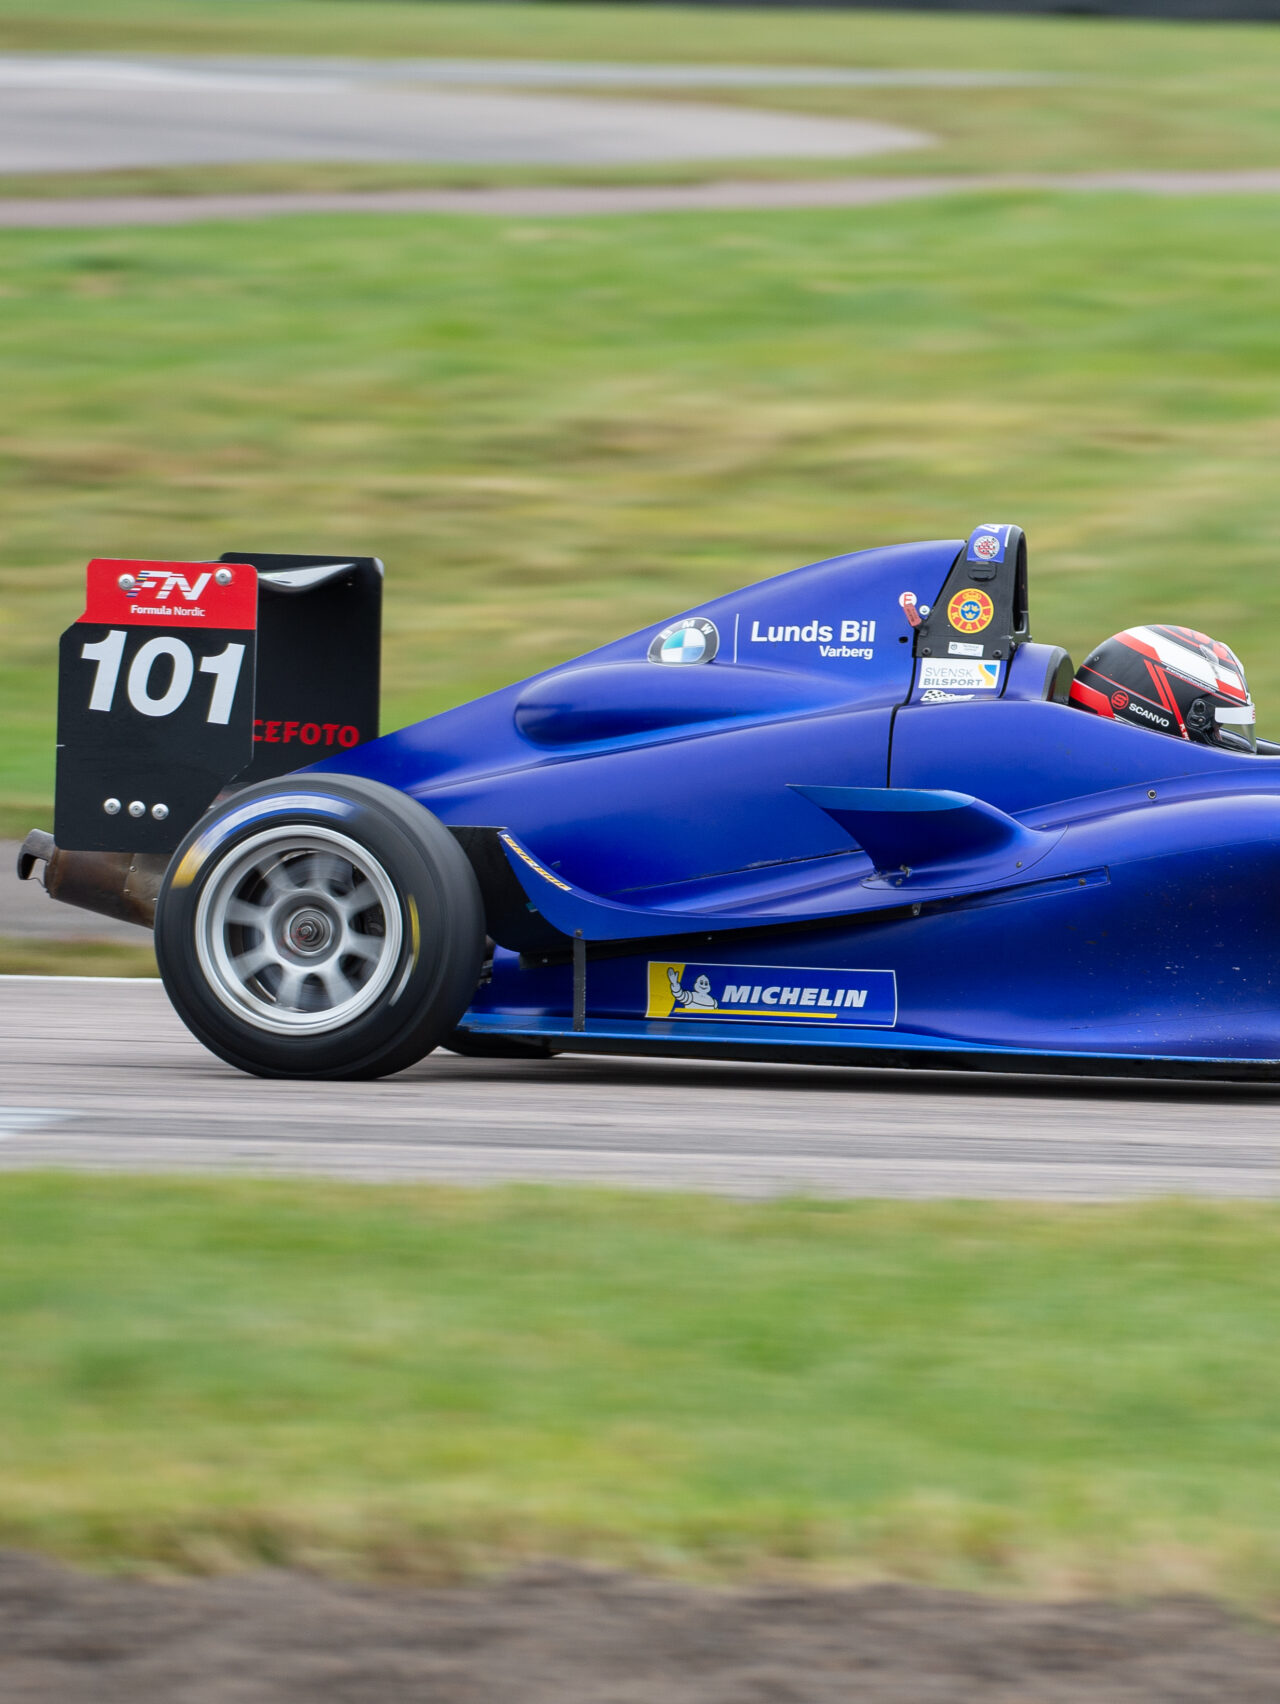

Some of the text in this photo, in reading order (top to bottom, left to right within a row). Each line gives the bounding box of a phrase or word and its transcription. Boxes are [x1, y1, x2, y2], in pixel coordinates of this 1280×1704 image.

[130, 604, 206, 617] Formula Nordic
[660, 619, 713, 640] BMW
[751, 620, 876, 643] Lunds Bil
[819, 644, 874, 660] Varberg
[80, 629, 246, 725] 101
[923, 678, 983, 686] BILSPORT
[924, 666, 975, 678] SVENSK
[1128, 702, 1170, 727] SCANVO
[721, 985, 868, 1008] MICHELIN
